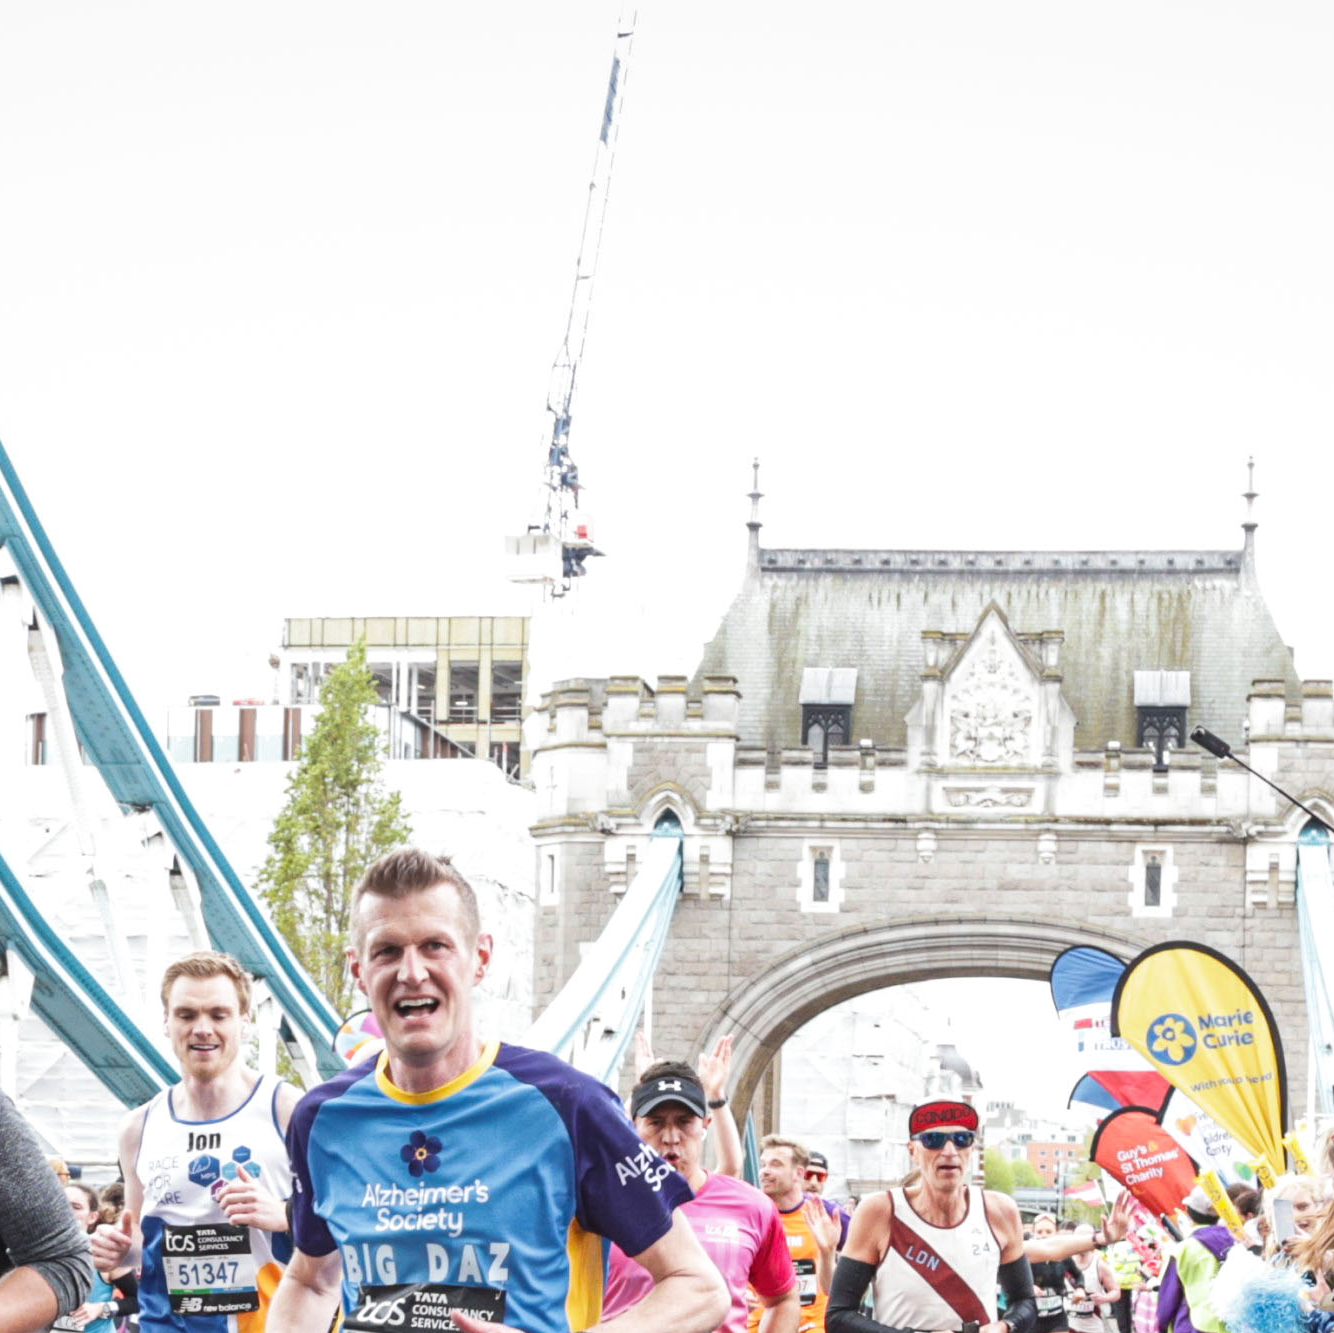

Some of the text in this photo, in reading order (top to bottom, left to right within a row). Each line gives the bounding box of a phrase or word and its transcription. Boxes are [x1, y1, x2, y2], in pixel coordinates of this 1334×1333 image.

[1198, 1008, 1254, 1031] Marie
[1202, 1030, 1254, 1049] Curie
[186, 1132, 221, 1152] Jon
[1117, 1144, 1148, 1163] Guy's
[615, 1142, 659, 1186] Alzh
[1120, 1160, 1134, 1174] St
[1125, 1165, 1164, 1185] Charity
[153, 1190, 183, 1207] ARE
[362, 1179, 489, 1208] Alzheimer's
[375, 1206, 463, 1237] Society
[165, 1229, 195, 1252] tcs
[197, 1235, 244, 1244] CONSULTANCY
[198, 1243, 229, 1251] SERVICES
[343, 1242, 510, 1285] BIG DAZ
[905, 1245, 940, 1271] LDN
[178, 1262, 238, 1285] 51347
[218, 1302, 252, 1312] balance
[413, 1292, 448, 1304] TATA
[357, 1295, 406, 1326] tcs
[410, 1317, 460, 1331] SERVICE
